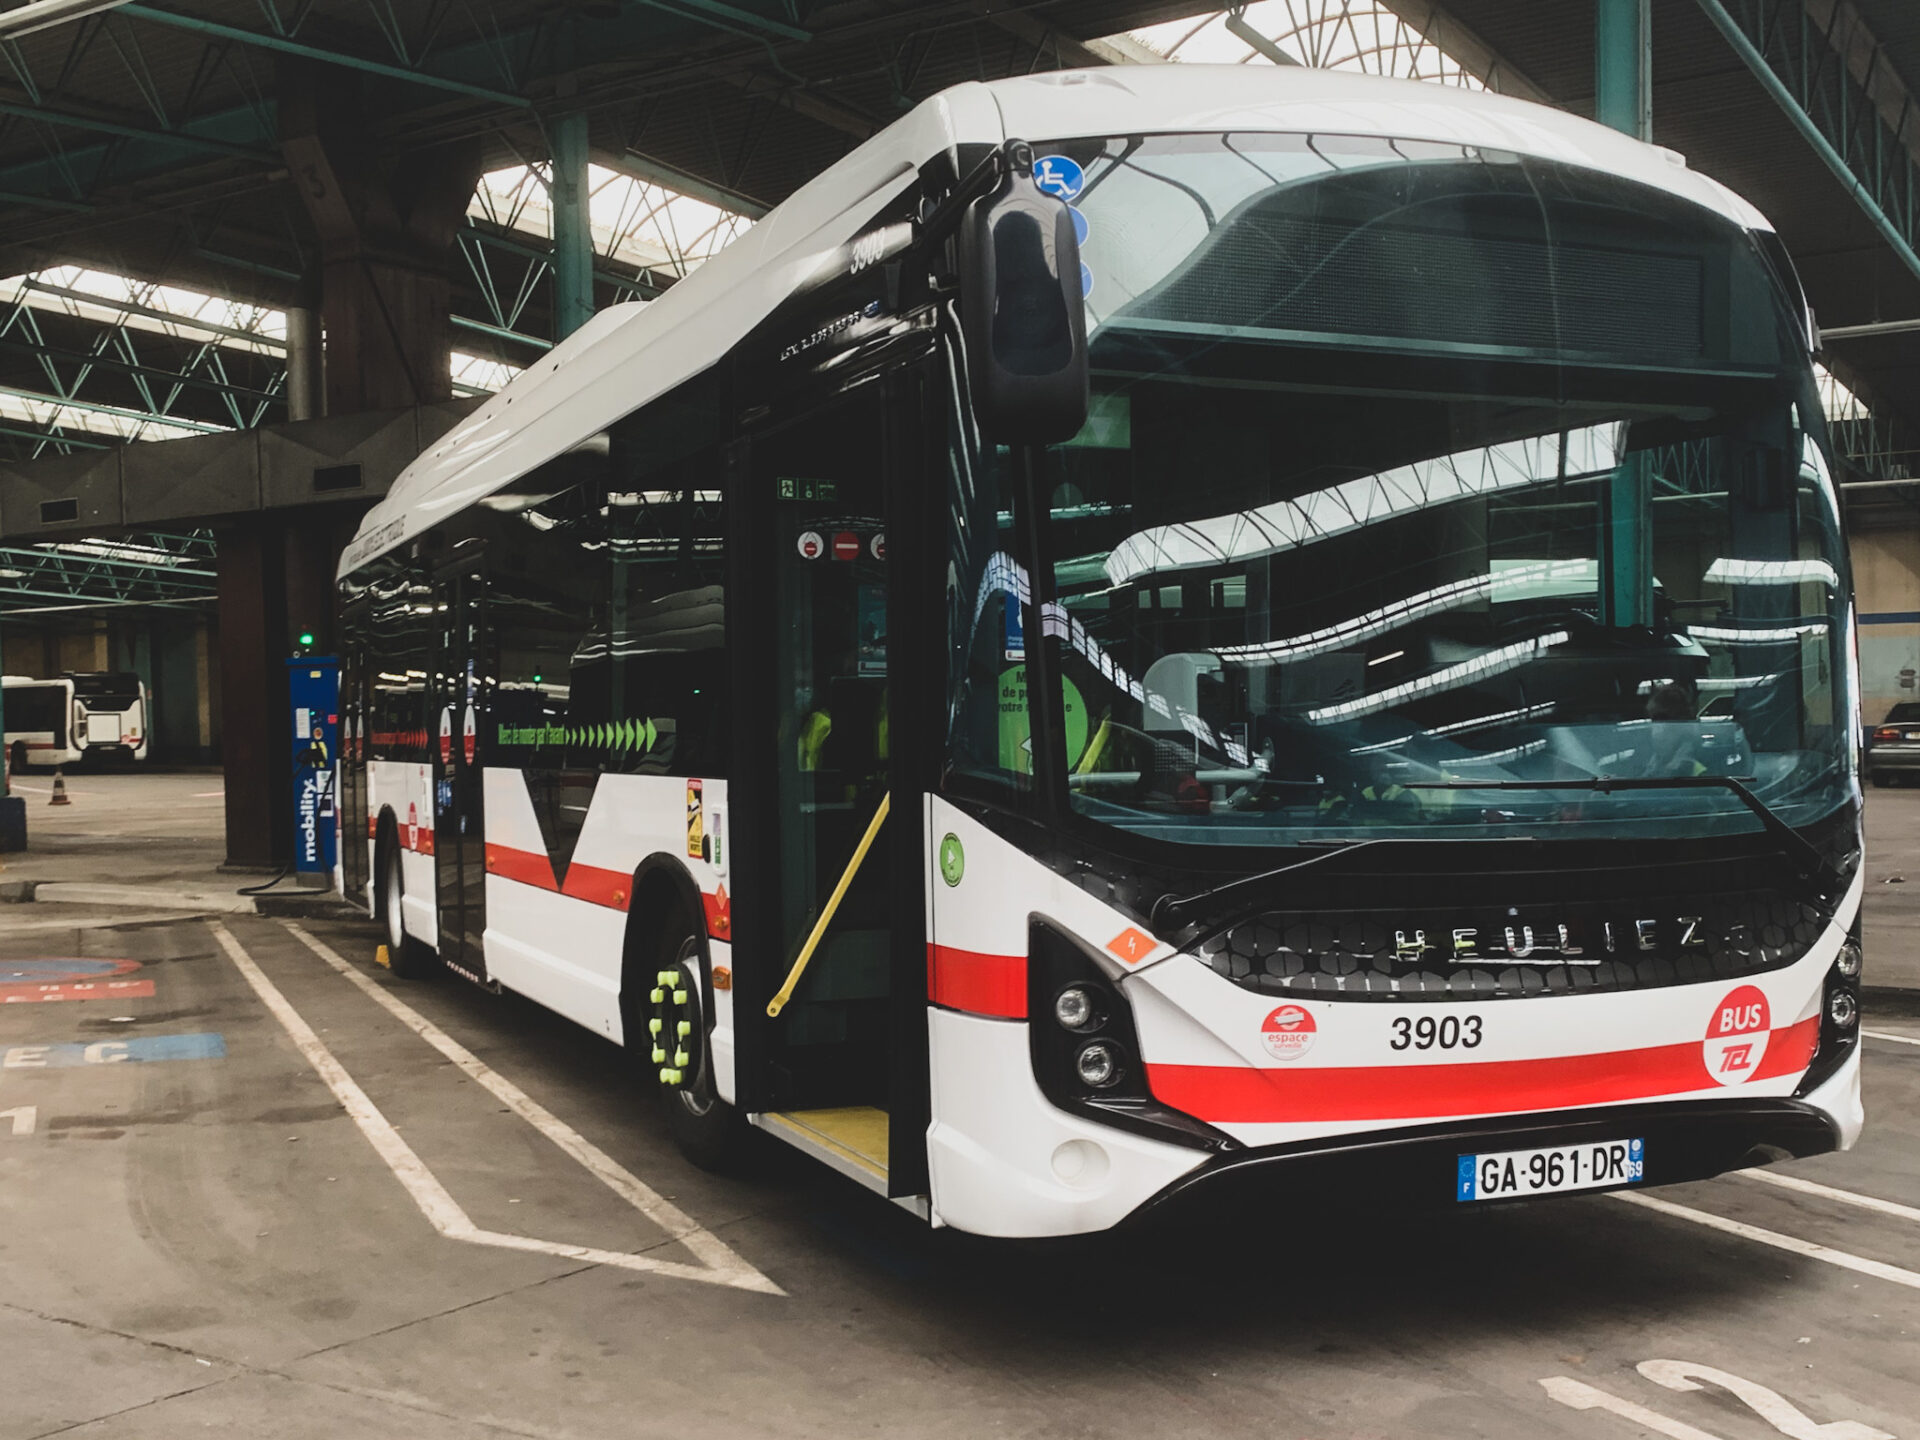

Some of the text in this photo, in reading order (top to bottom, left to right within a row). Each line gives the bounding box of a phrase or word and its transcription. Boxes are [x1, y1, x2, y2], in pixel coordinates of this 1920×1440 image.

[851, 227, 885, 274] 3903
[1393, 915, 1704, 961] HEULIEZ
[1390, 1015, 1482, 1050] 3903
[1720, 1004, 1762, 1033] BUS
[1268, 1034, 1308, 1043] espace
[1720, 1043, 1754, 1073] TCL
[1482, 1145, 1626, 1194] GA-961-DR
[1628, 1160, 1642, 1178] 69
[1463, 1182, 1470, 1194] F
